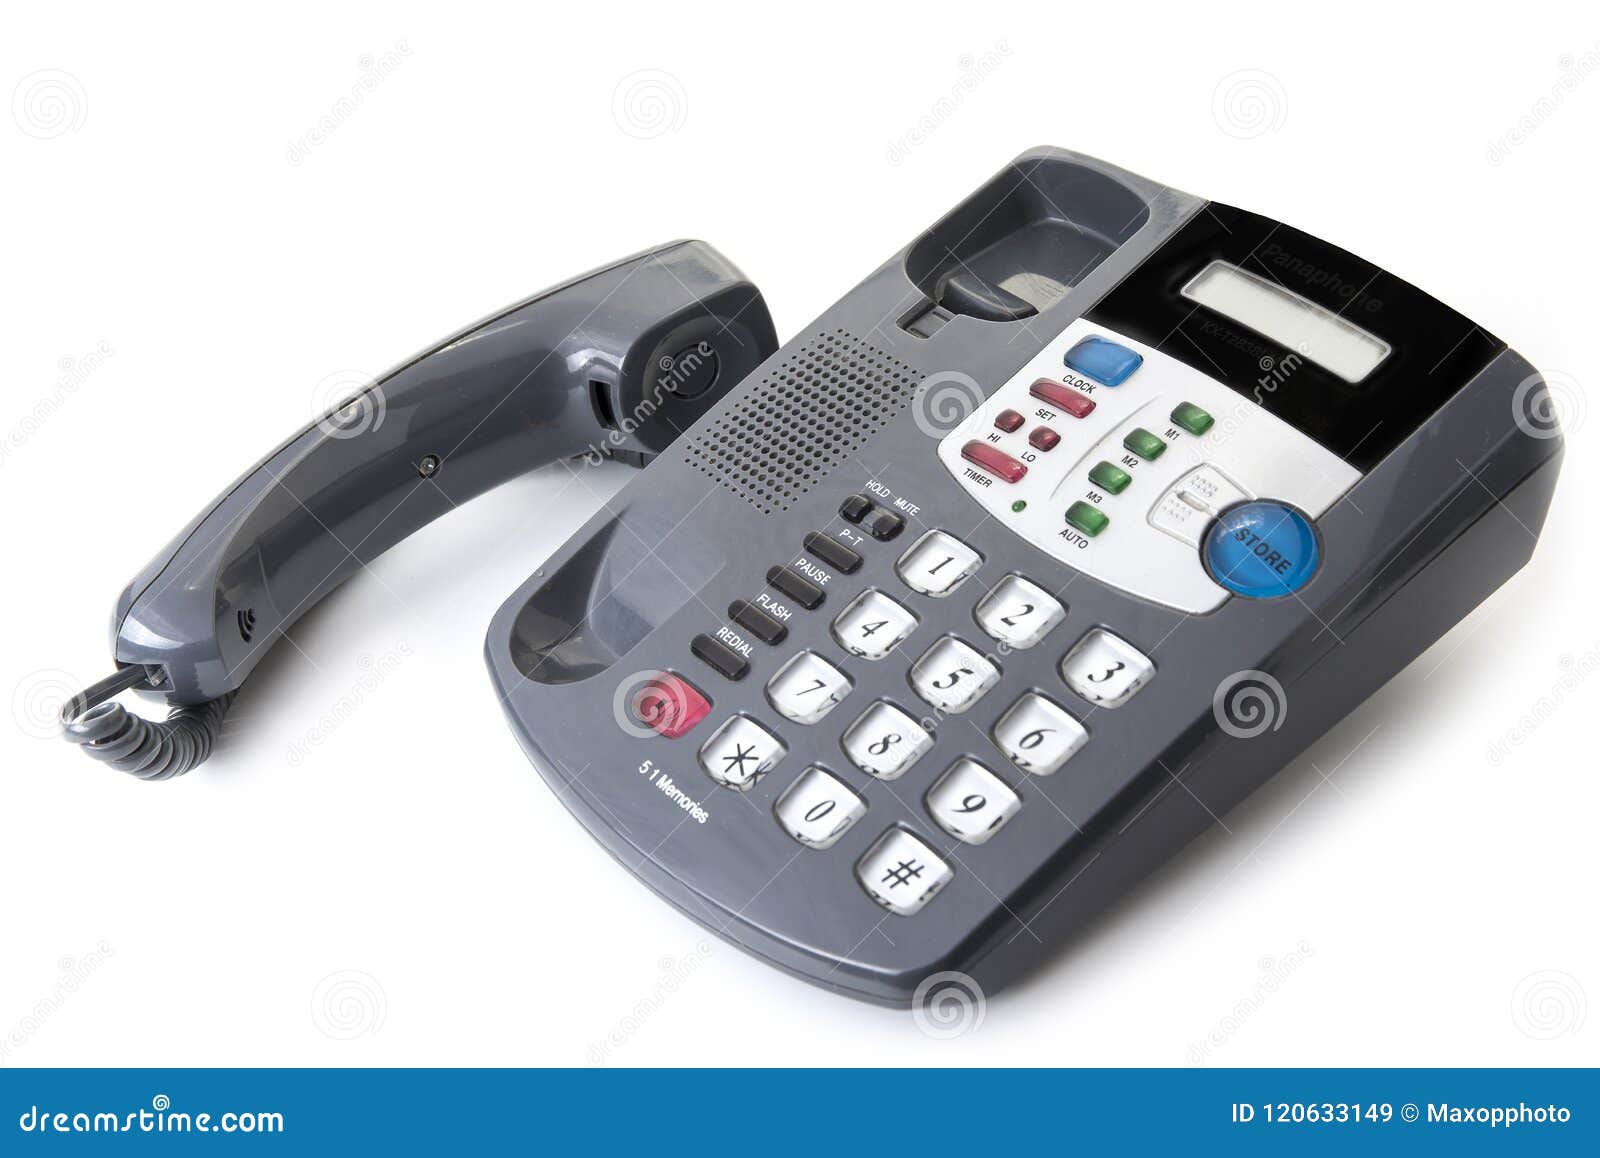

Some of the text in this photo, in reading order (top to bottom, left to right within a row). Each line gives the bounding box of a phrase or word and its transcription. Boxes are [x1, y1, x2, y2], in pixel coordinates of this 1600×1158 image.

[1063, 374, 1097, 394] CLOCK
[1035, 408, 1057, 421] SET
[987, 432, 1001, 443] HI
[1164, 428, 1180, 441] M1
[1021, 451, 1036, 462] LO
[1121, 455, 1139, 468] M2
[865, 479, 891, 498] HOLD
[963, 468, 993, 488] TIMER
[893, 497, 920, 516] MUTE
[1086, 491, 1103, 504] M3
[839, 528, 864, 546] P-T
[1058, 528, 1089, 549] AUTO
[1234, 527, 1292, 575] STORE
[795, 558, 831, 585] PAUSE
[927, 555, 956, 576] 1
[756, 593, 792, 621] FLASH
[1000, 603, 1034, 627] 2
[861, 618, 890, 638] 4
[716, 626, 753, 658] REDIAL
[932, 667, 975, 690] 5
[1087, 660, 1126, 683] 3
[796, 679, 826, 697] 7
[867, 733, 902, 756] 8
[1018, 727, 1057, 750] 6
[655, 774, 710, 824] Memories
[950, 793, 987, 815] 9
[804, 799, 836, 823] 0
[881, 858, 925, 889] #
